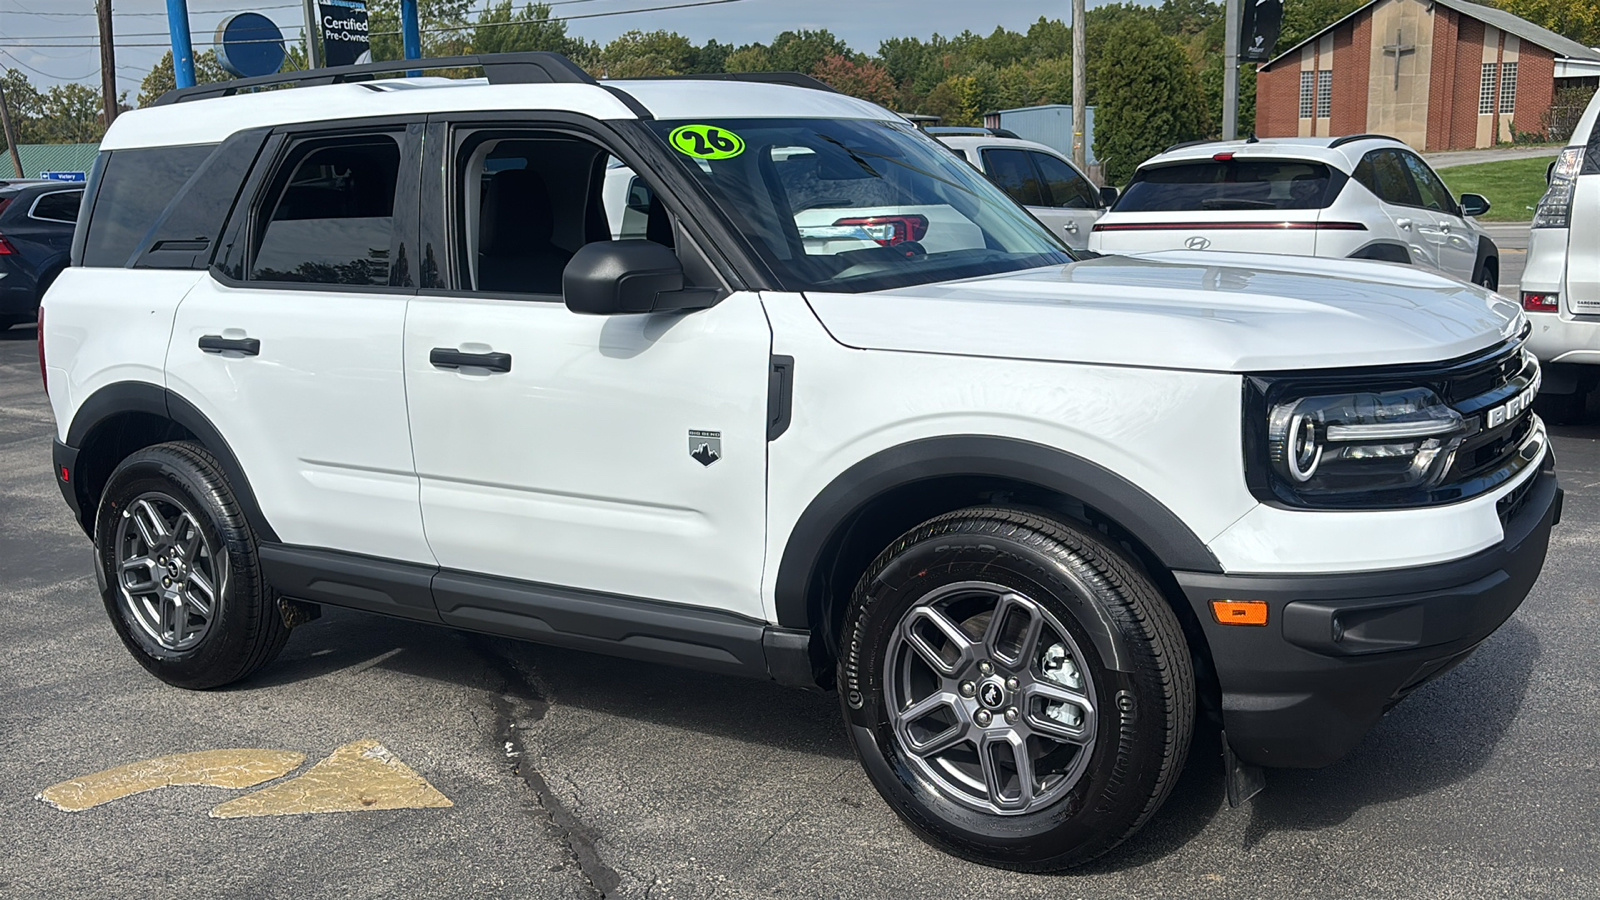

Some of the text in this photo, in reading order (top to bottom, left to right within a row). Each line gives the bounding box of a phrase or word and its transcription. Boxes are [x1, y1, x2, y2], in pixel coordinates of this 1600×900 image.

[323, 16, 369, 31] Certified
[681, 128, 736, 155] 26
[846, 605, 871, 710] Continental
